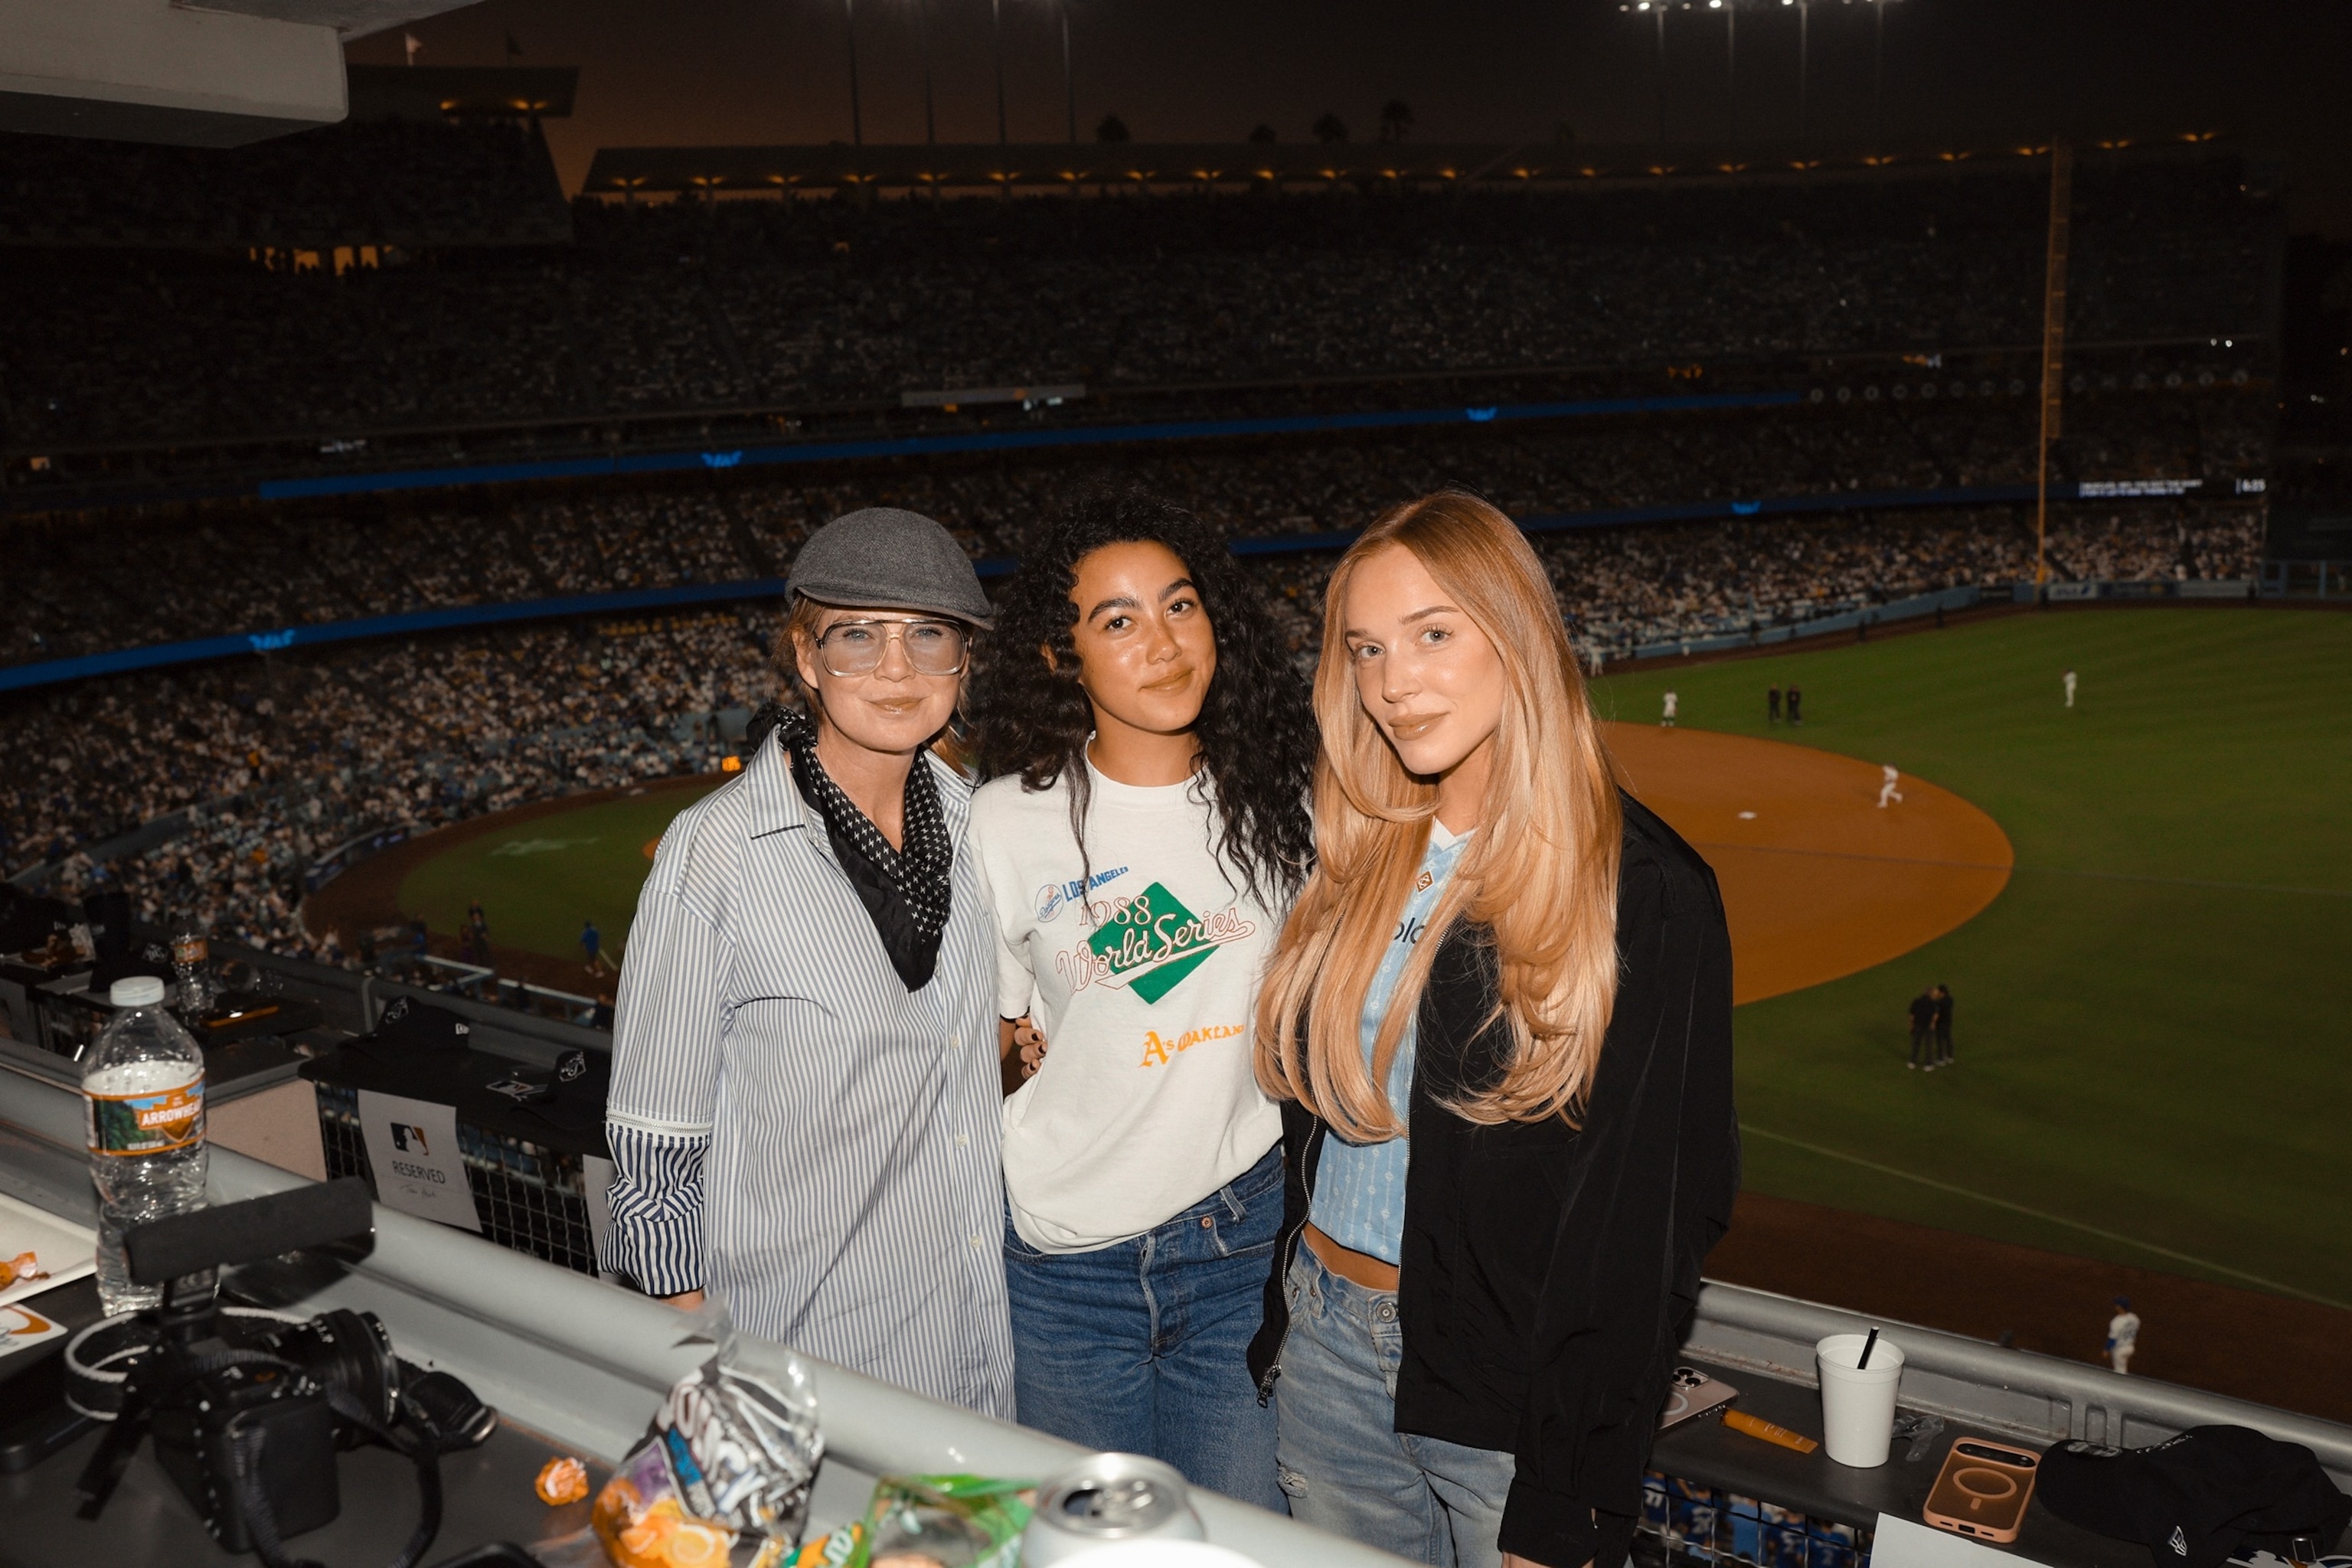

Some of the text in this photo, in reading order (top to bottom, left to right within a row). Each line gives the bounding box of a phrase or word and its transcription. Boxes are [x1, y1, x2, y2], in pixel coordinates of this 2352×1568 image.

[1089, 866, 1129, 890] ANGELES
[1079, 895, 1152, 929] 1988
[1055, 907, 1243, 996] World Series
[392, 1160, 446, 1184] RESERVED
